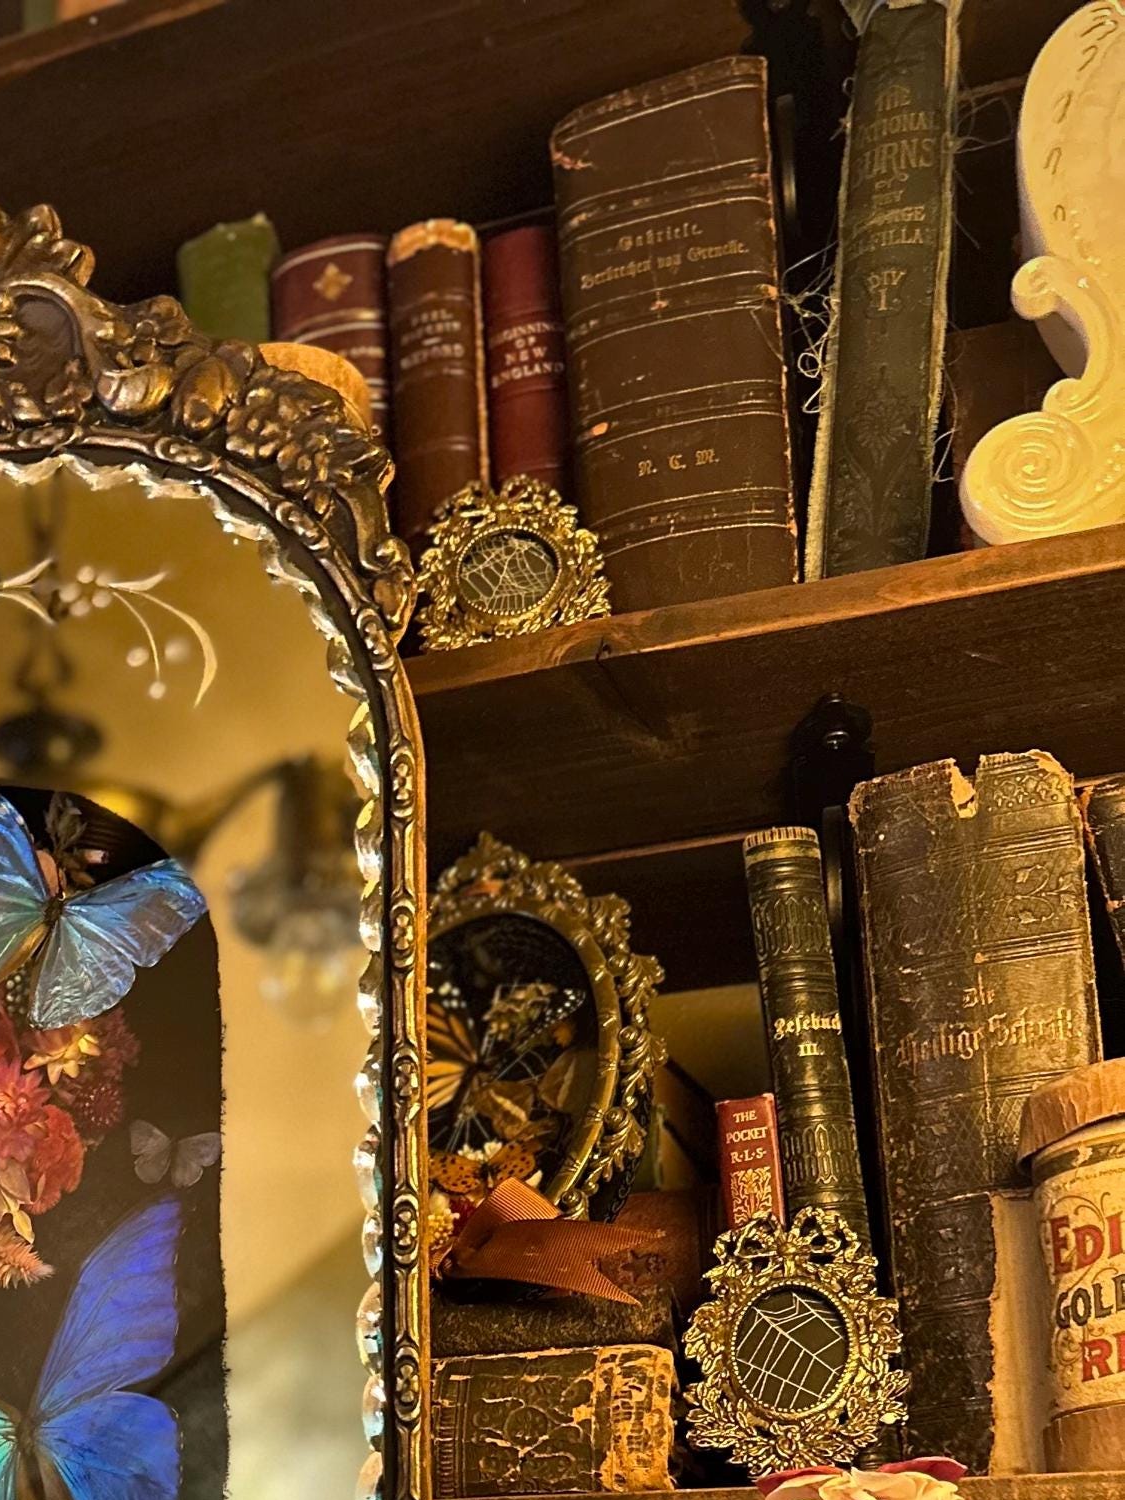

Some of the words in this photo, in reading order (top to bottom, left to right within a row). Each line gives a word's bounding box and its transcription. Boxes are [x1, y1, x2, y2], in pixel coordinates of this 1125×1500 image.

[515, 335, 536, 349] OF
[504, 346, 548, 366] NEW
[491, 361, 565, 389] ENGLAND
[732, 1110, 758, 1124] THE
[725, 1126, 768, 1145] POCKET
